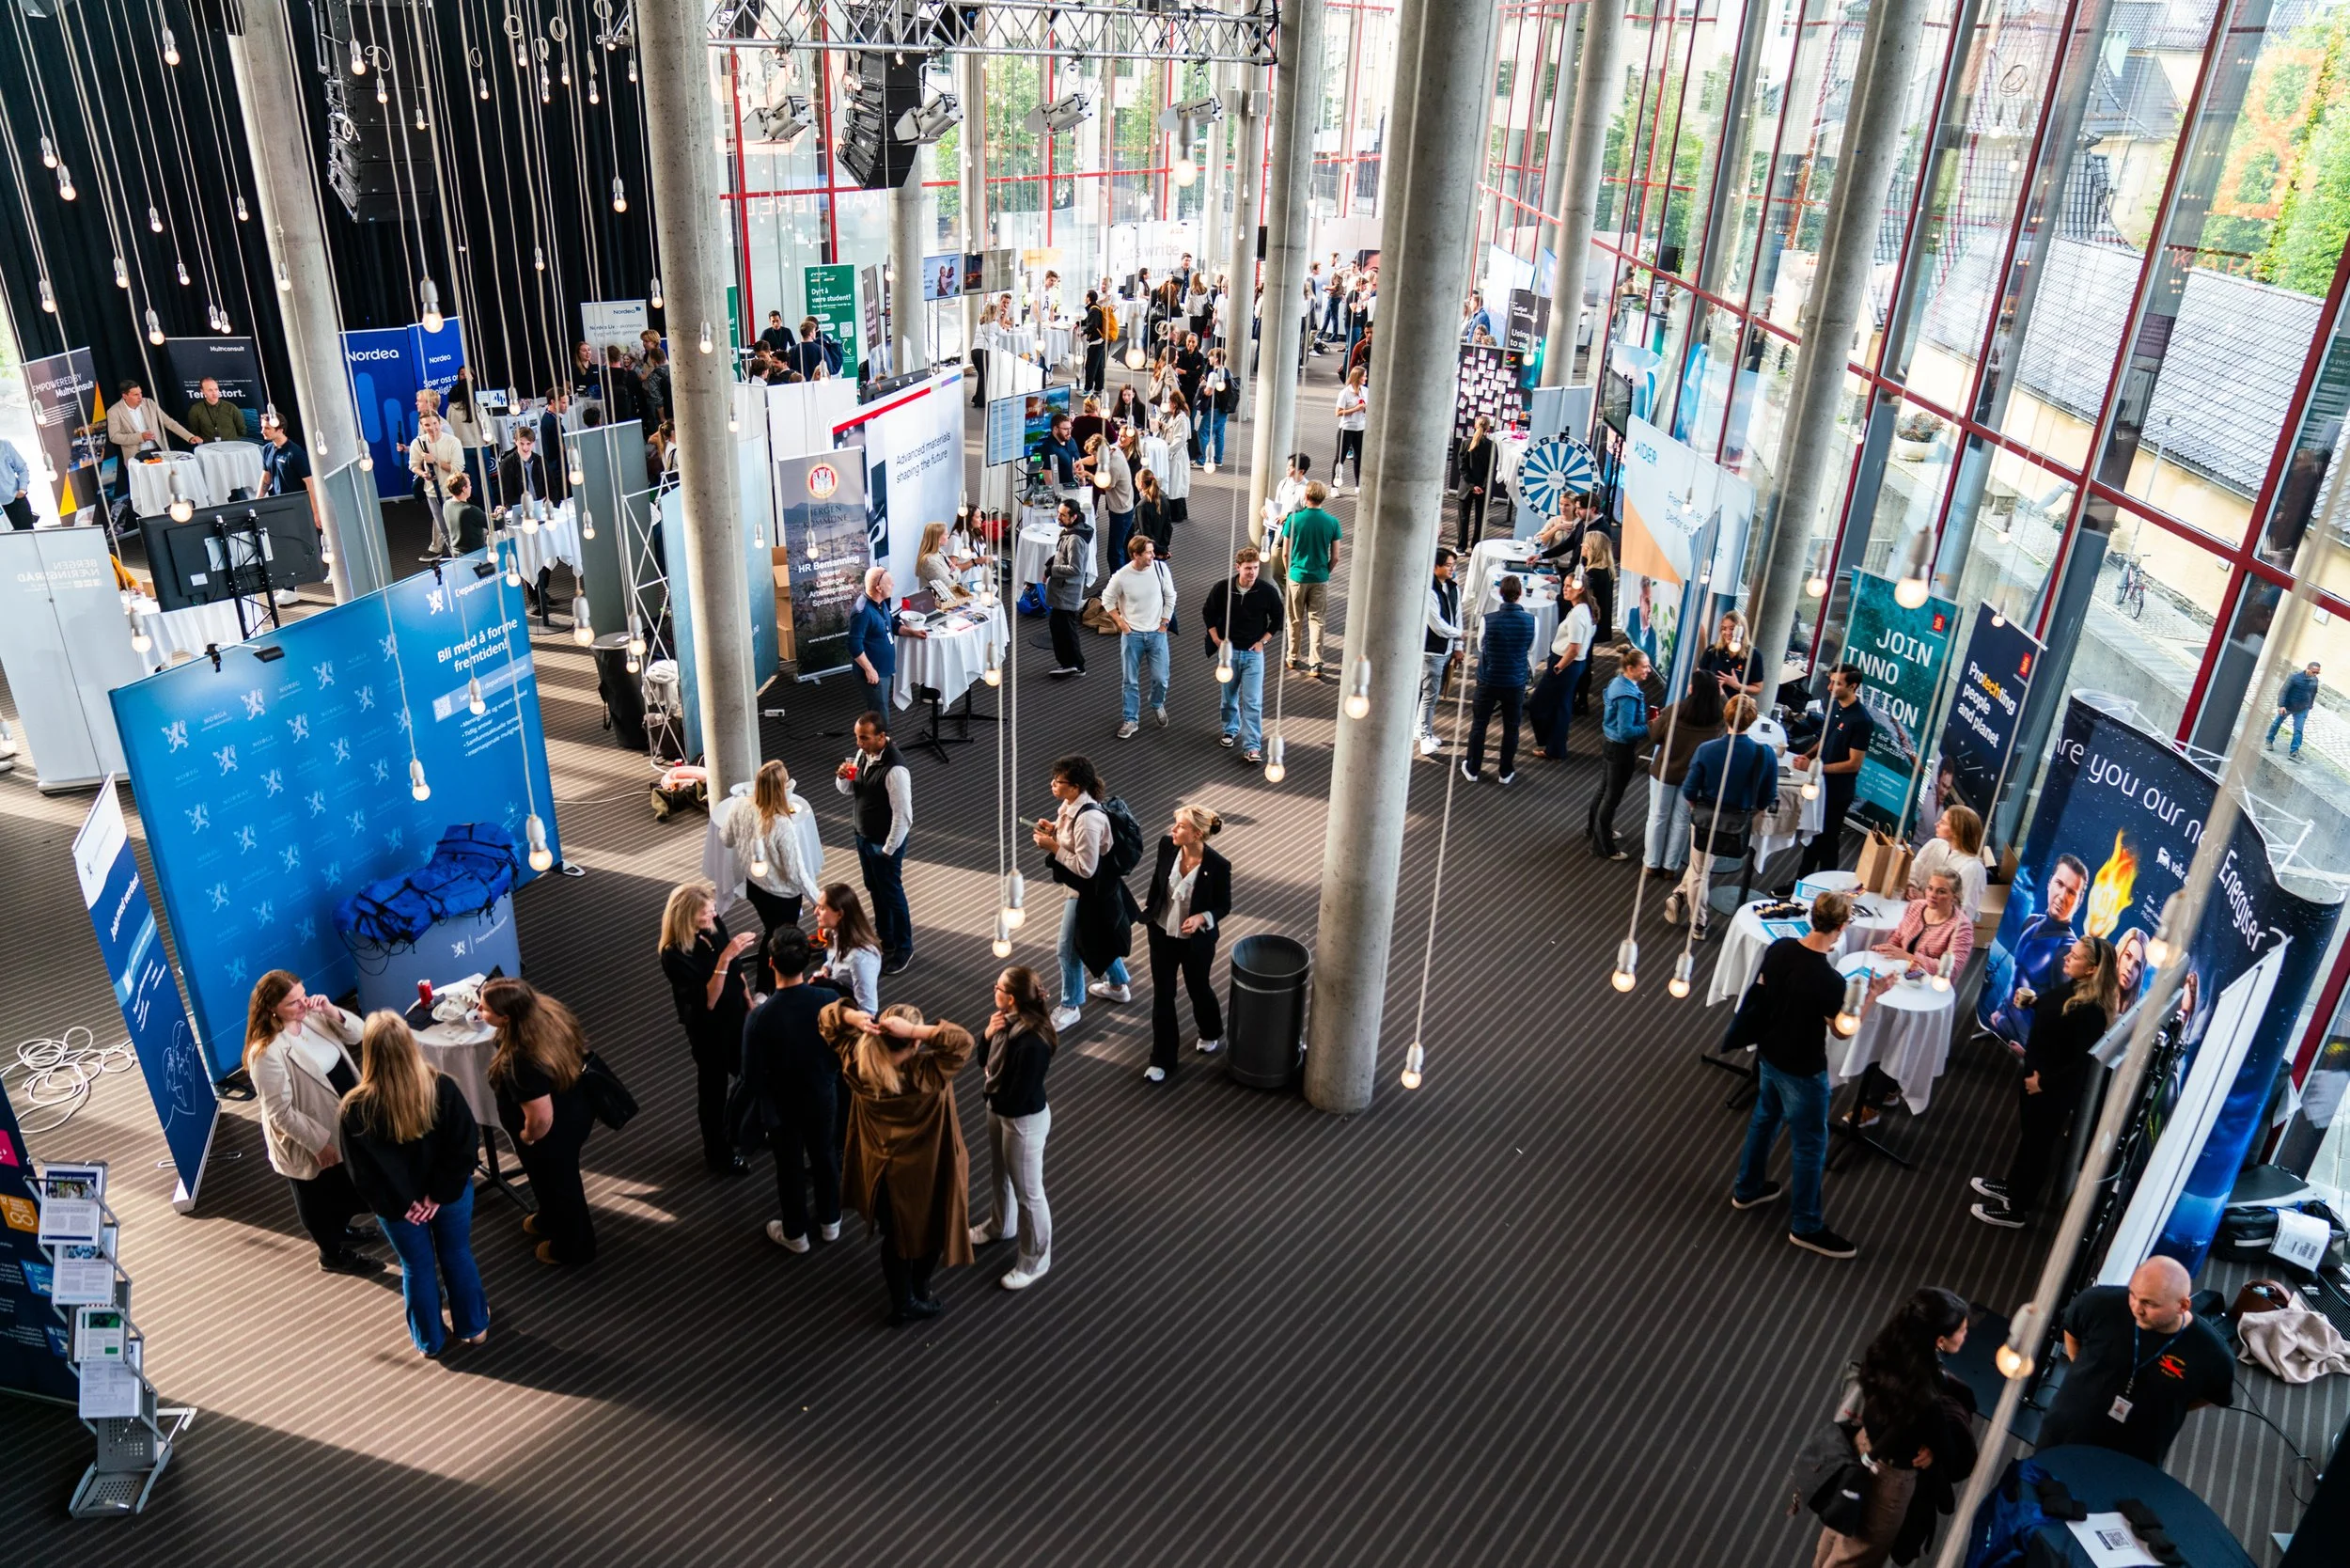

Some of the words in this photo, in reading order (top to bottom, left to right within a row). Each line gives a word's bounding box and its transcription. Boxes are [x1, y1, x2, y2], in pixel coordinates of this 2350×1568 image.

[1512, 329, 1530, 340] Using
[345, 349, 400, 362] Nordea
[429, 354, 451, 364] Nordea
[32, 375, 73, 394] EMPOWERED
[55, 380, 94, 399] Multicnsult
[440, 376, 452, 384] oss
[896, 442, 925, 466] Advanced
[925, 431, 951, 451] materials
[1635, 440, 1657, 466] AIDER
[896, 464, 919, 484] shaping
[920, 459, 931, 471] the
[931, 449, 948, 465] future
[809, 504, 842, 517] BERGEN
[803, 514, 848, 529] KOMMUNE
[798, 563, 811, 573] HR
[813, 555, 860, 571] Bemanning
[819, 568, 842, 578] Vikarer
[808, 583, 854, 599] Arbeidspraksis
[812, 592, 853, 607] Språkpraksis
[437, 647, 452, 663] Bli
[453, 633, 478, 656] med
[478, 630, 486, 644] å
[487, 619, 518, 643] forme
[1875, 628, 1934, 667] JOIN
[453, 637, 509, 673] fremtiden!
[1847, 645, 1900, 685] INNO
[278, 681, 300, 693] NOREG
[1968, 661, 2017, 716] Protechting
[1856, 682, 1919, 729] ATION
[1962, 682, 1991, 715] people
[1957, 702, 1976, 724] and
[1971, 716, 1999, 748] planet
[1877, 733, 1888, 743] find
[1875, 741, 1907, 760] solutions
[2087, 754, 2140, 797] you
[2142, 787, 2186, 827] our
[2171, 861, 2186, 880] vår
[123, 870, 141, 903] verden!
